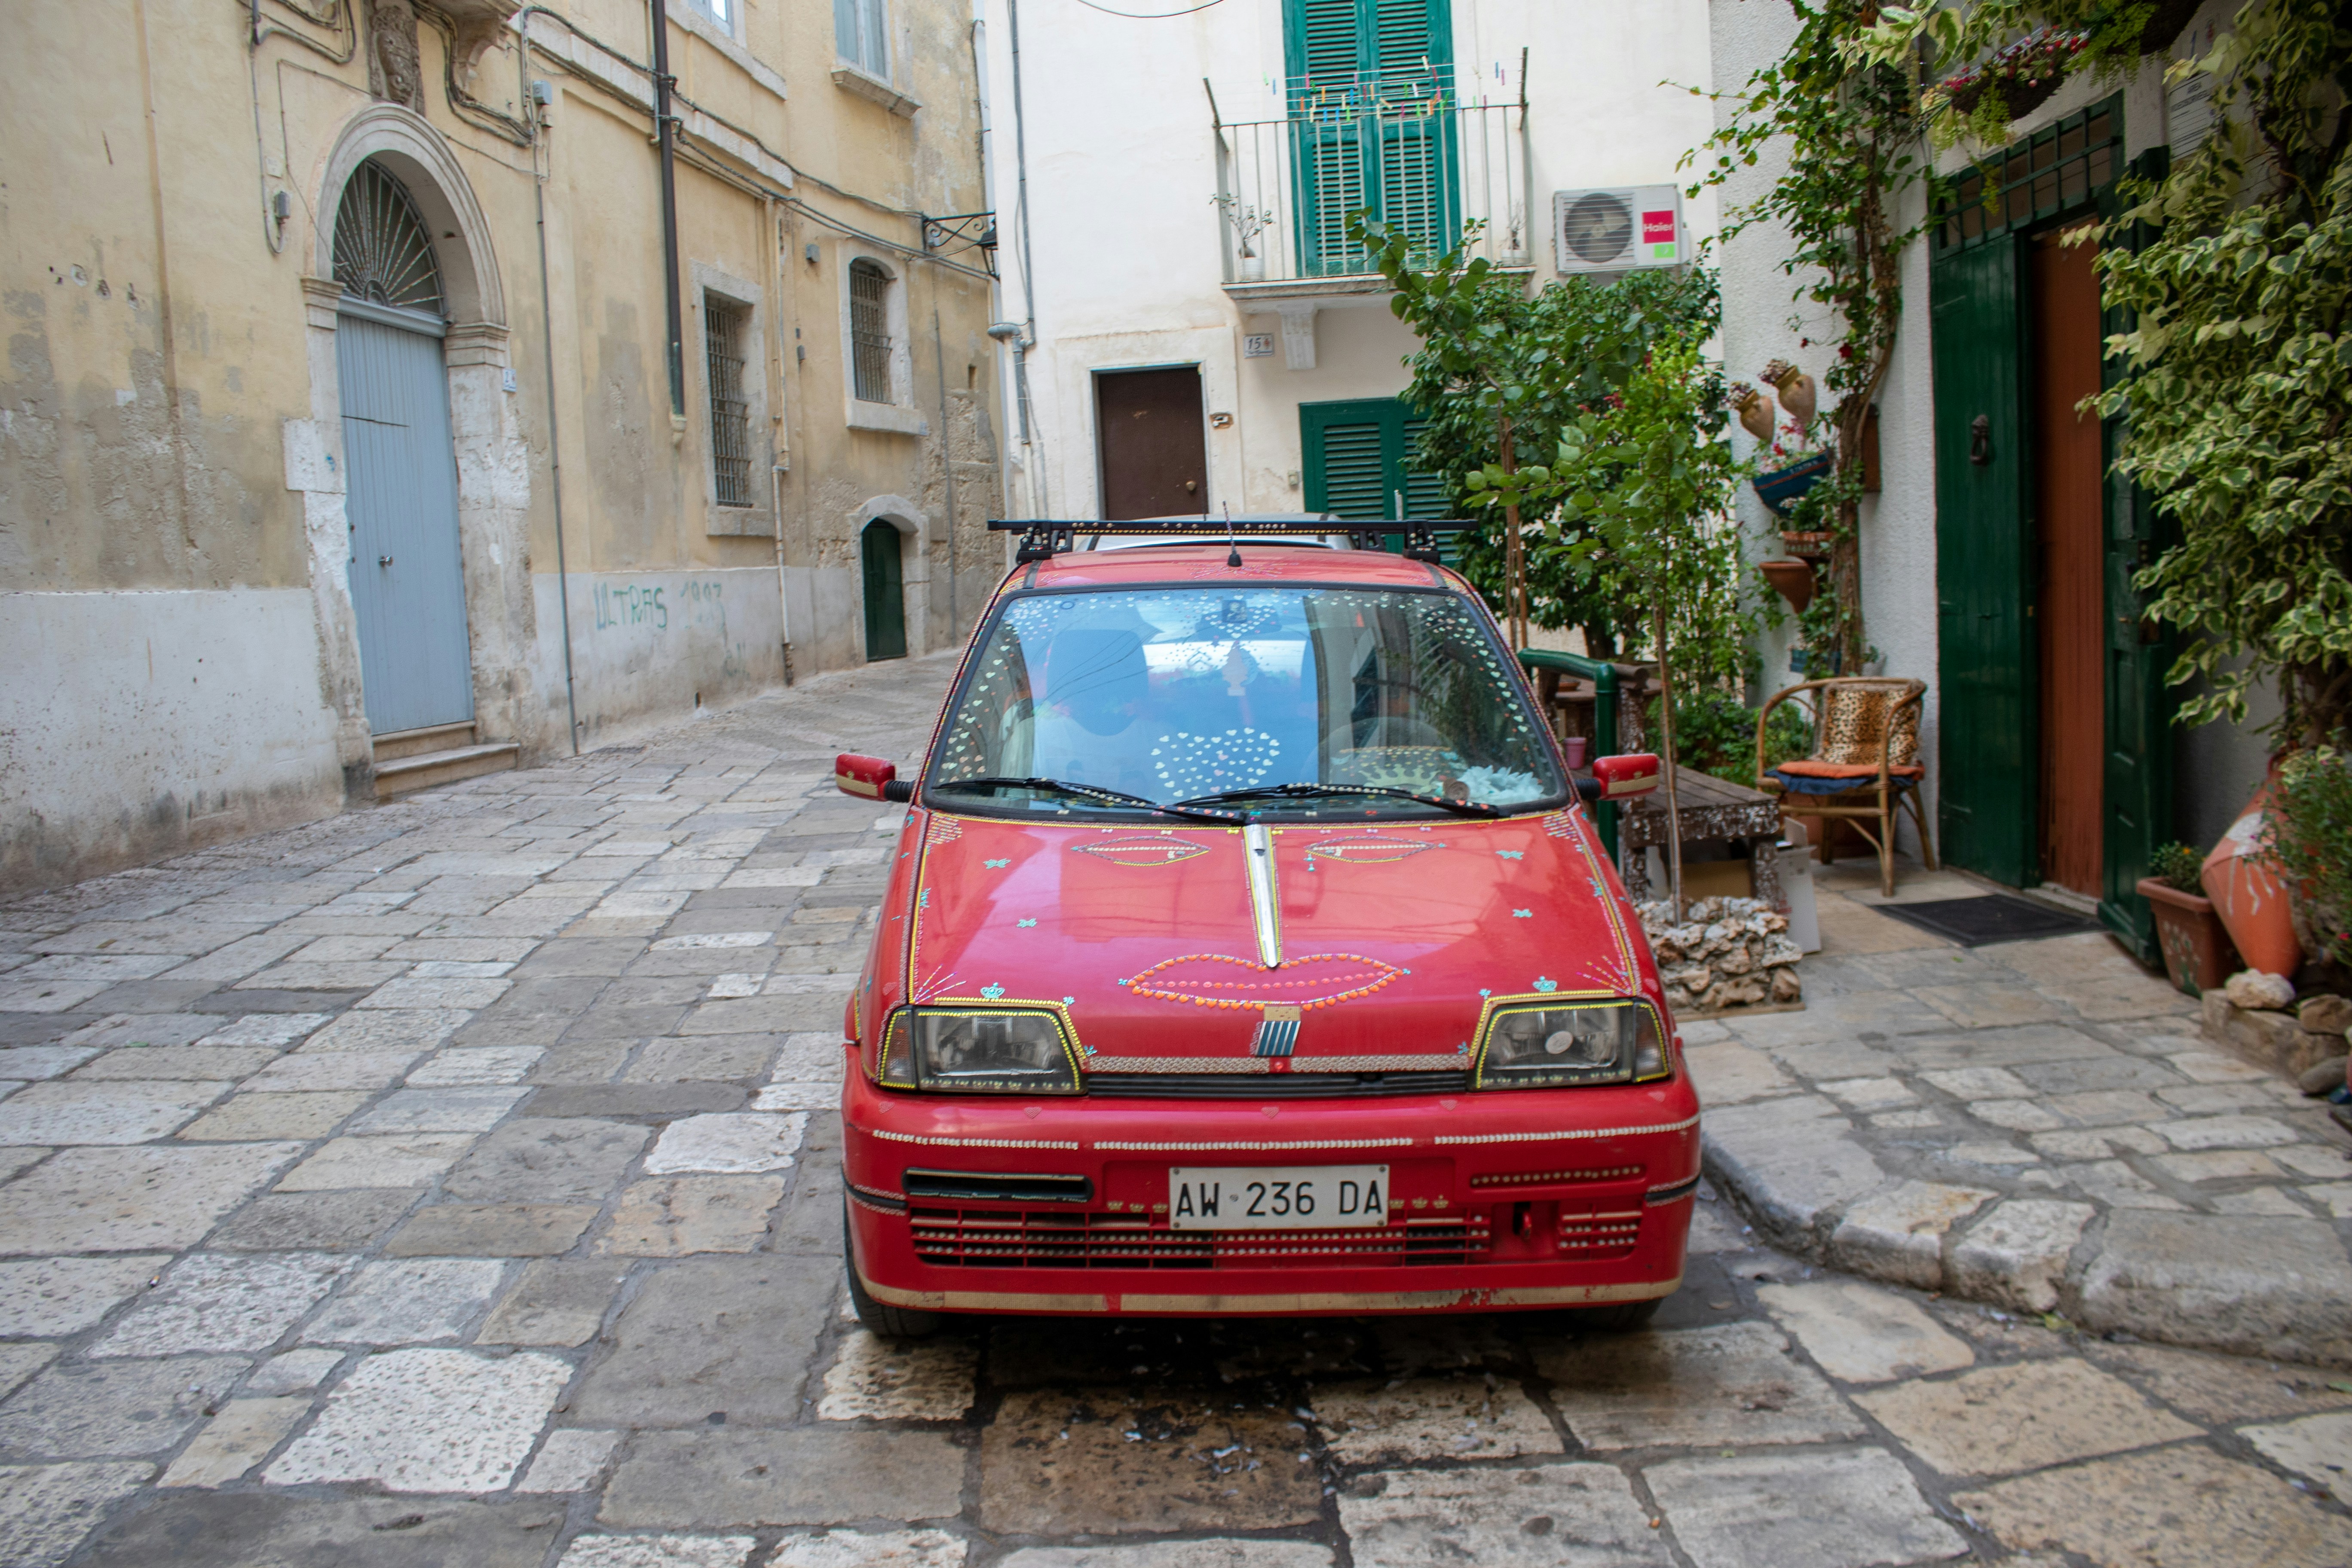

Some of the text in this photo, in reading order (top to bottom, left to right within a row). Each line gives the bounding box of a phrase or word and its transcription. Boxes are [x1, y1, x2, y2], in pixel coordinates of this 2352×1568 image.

[1643, 222, 1674, 233] Haier
[1248, 337, 1262, 350] 15
[1176, 1179, 1382, 1217] AW 236 DA
